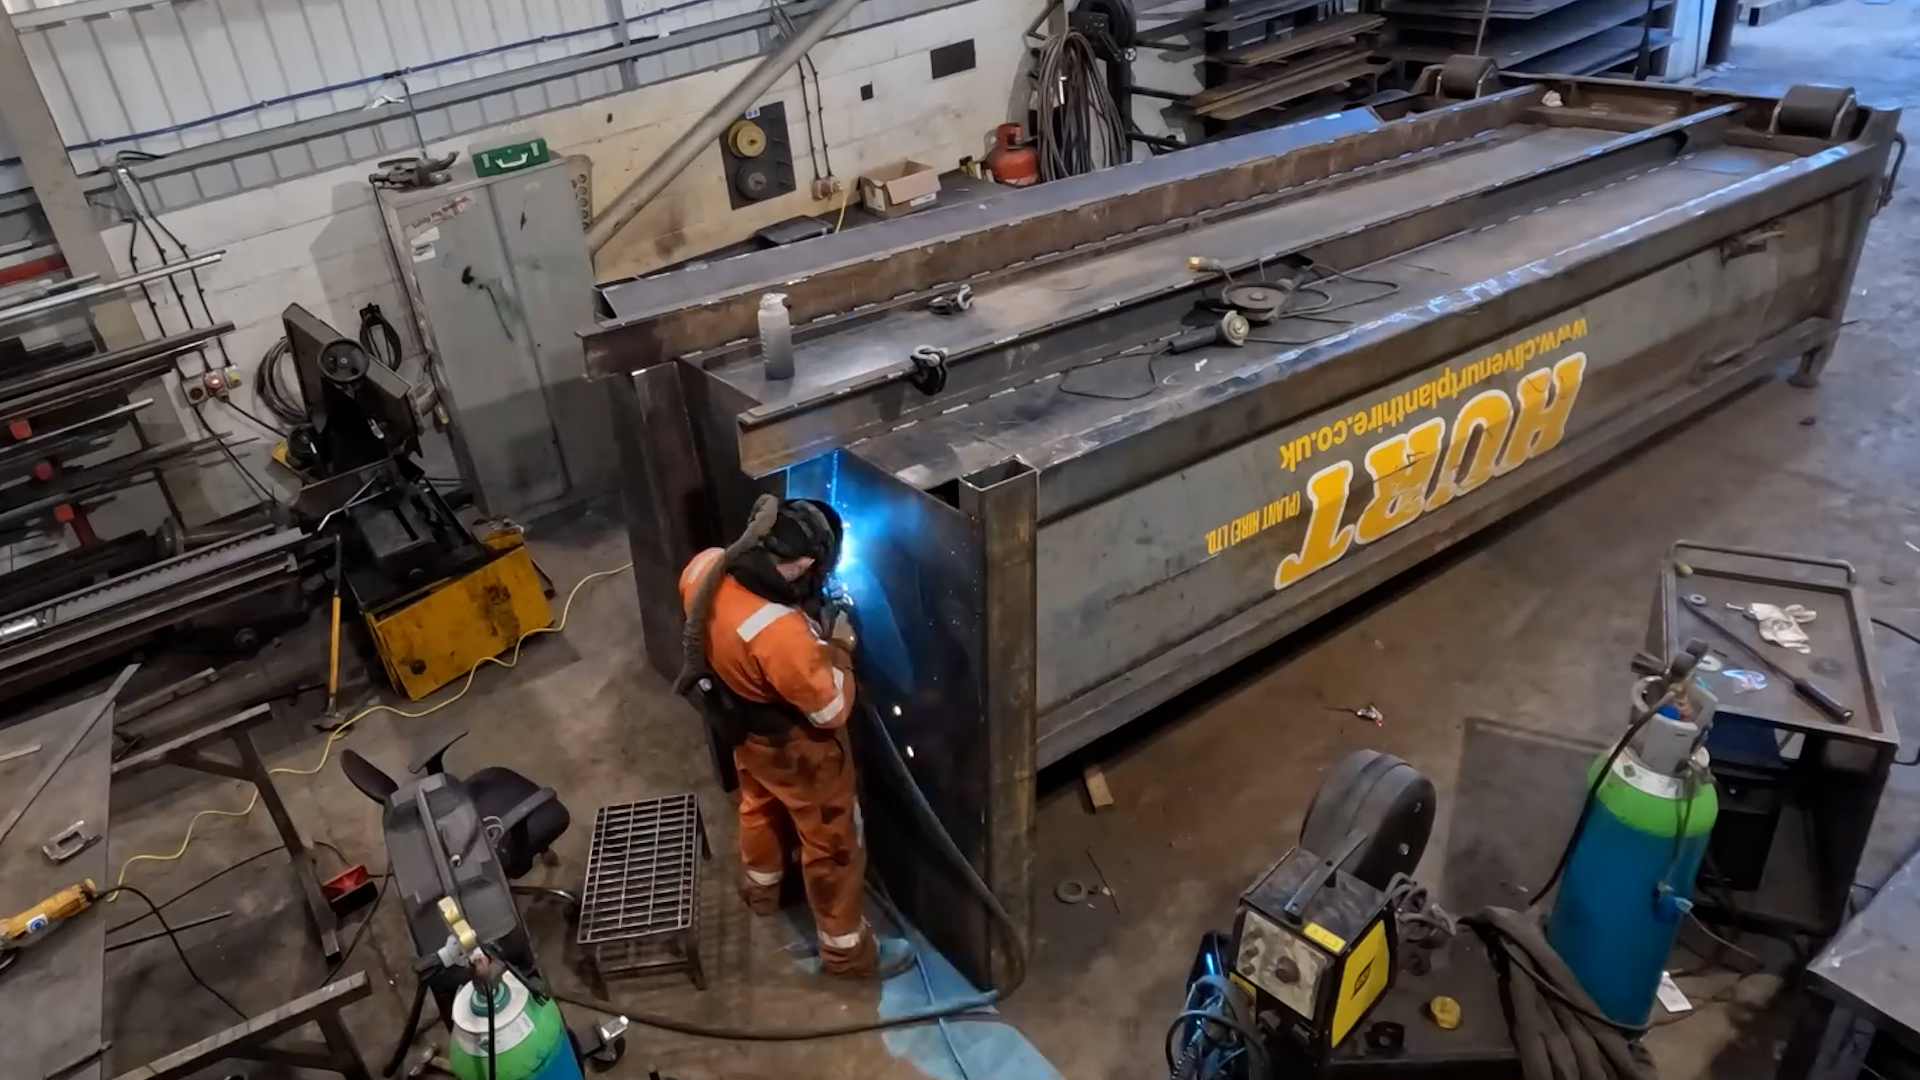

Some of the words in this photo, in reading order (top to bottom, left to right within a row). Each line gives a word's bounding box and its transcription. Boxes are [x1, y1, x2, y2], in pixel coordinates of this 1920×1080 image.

[1274, 351, 1587, 590] HURT
[1230, 510, 1260, 547] HIRE)
[1261, 490, 1301, 531] (PLANT
[1205, 524, 1229, 555] LTD.
